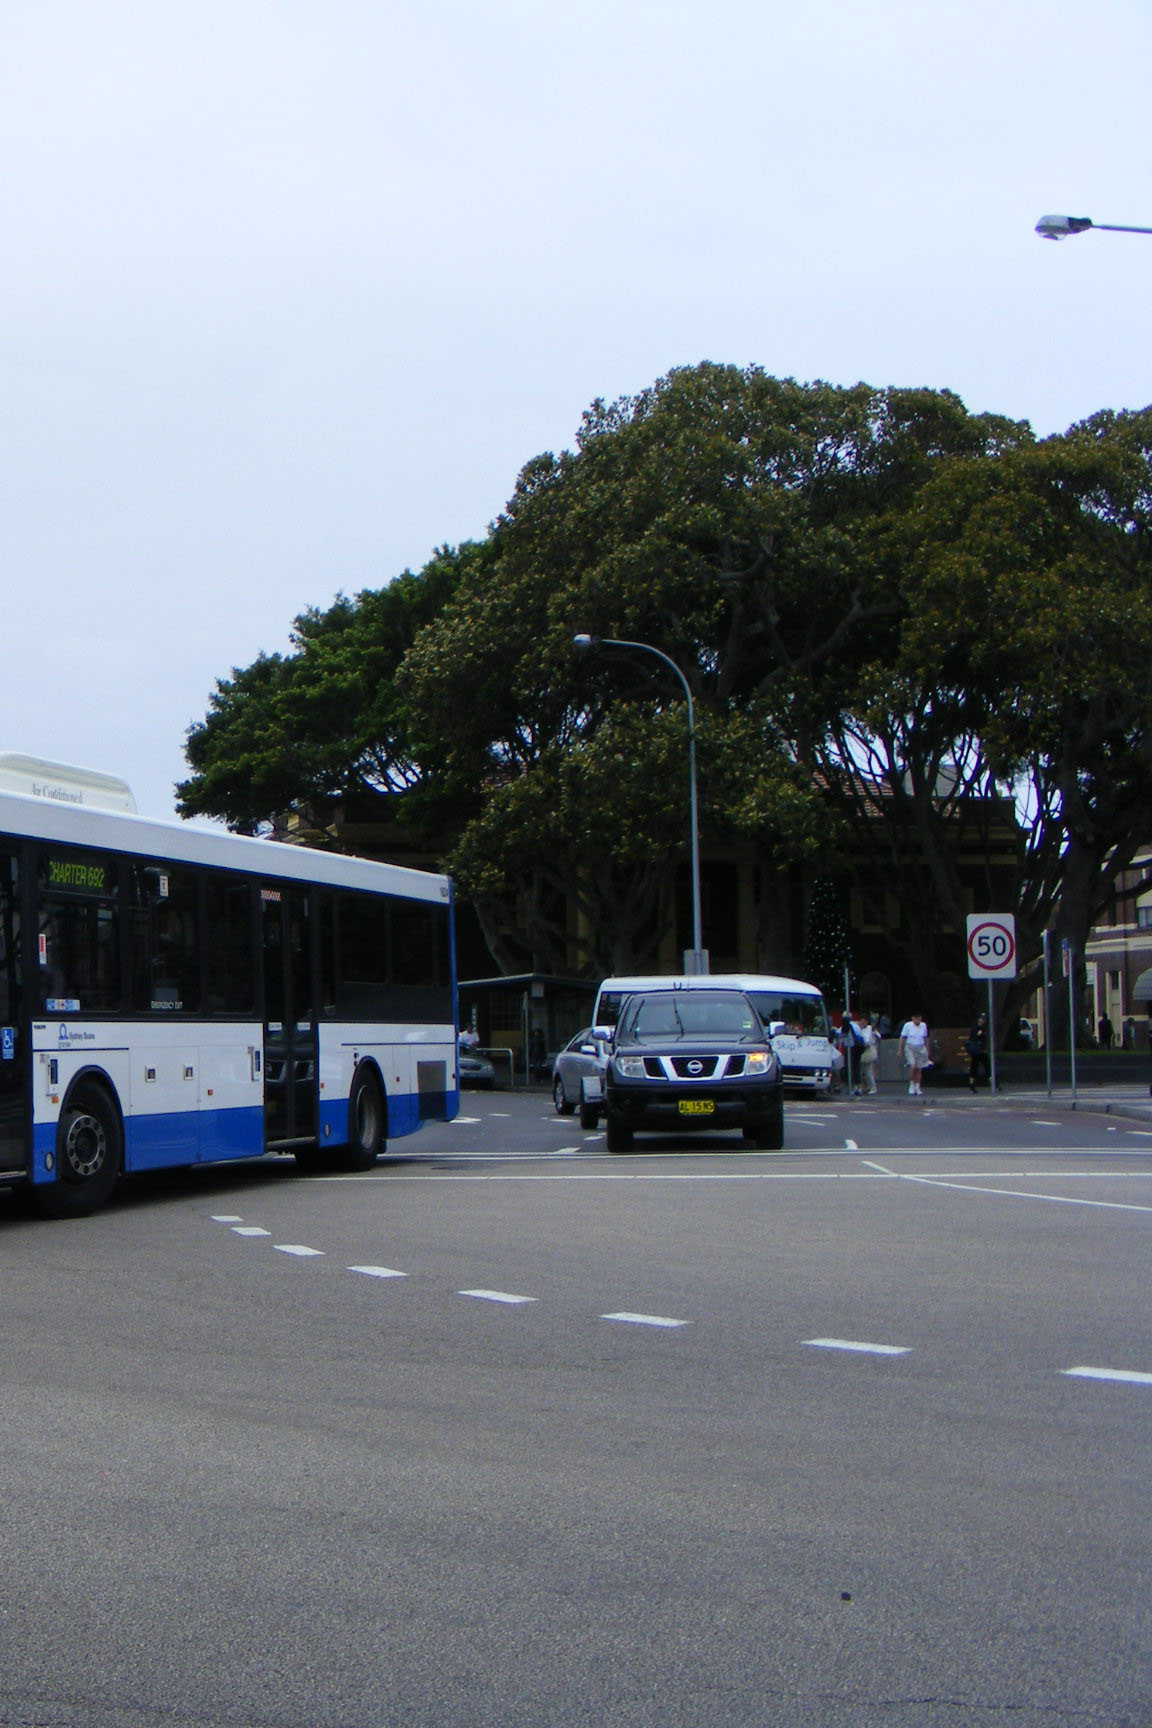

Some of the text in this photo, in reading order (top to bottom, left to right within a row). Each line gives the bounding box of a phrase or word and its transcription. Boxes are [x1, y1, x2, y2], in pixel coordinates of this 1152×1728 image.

[87, 868, 105, 888] 692
[978, 935, 1006, 956] 50
[777, 1040, 796, 1051] Skip
